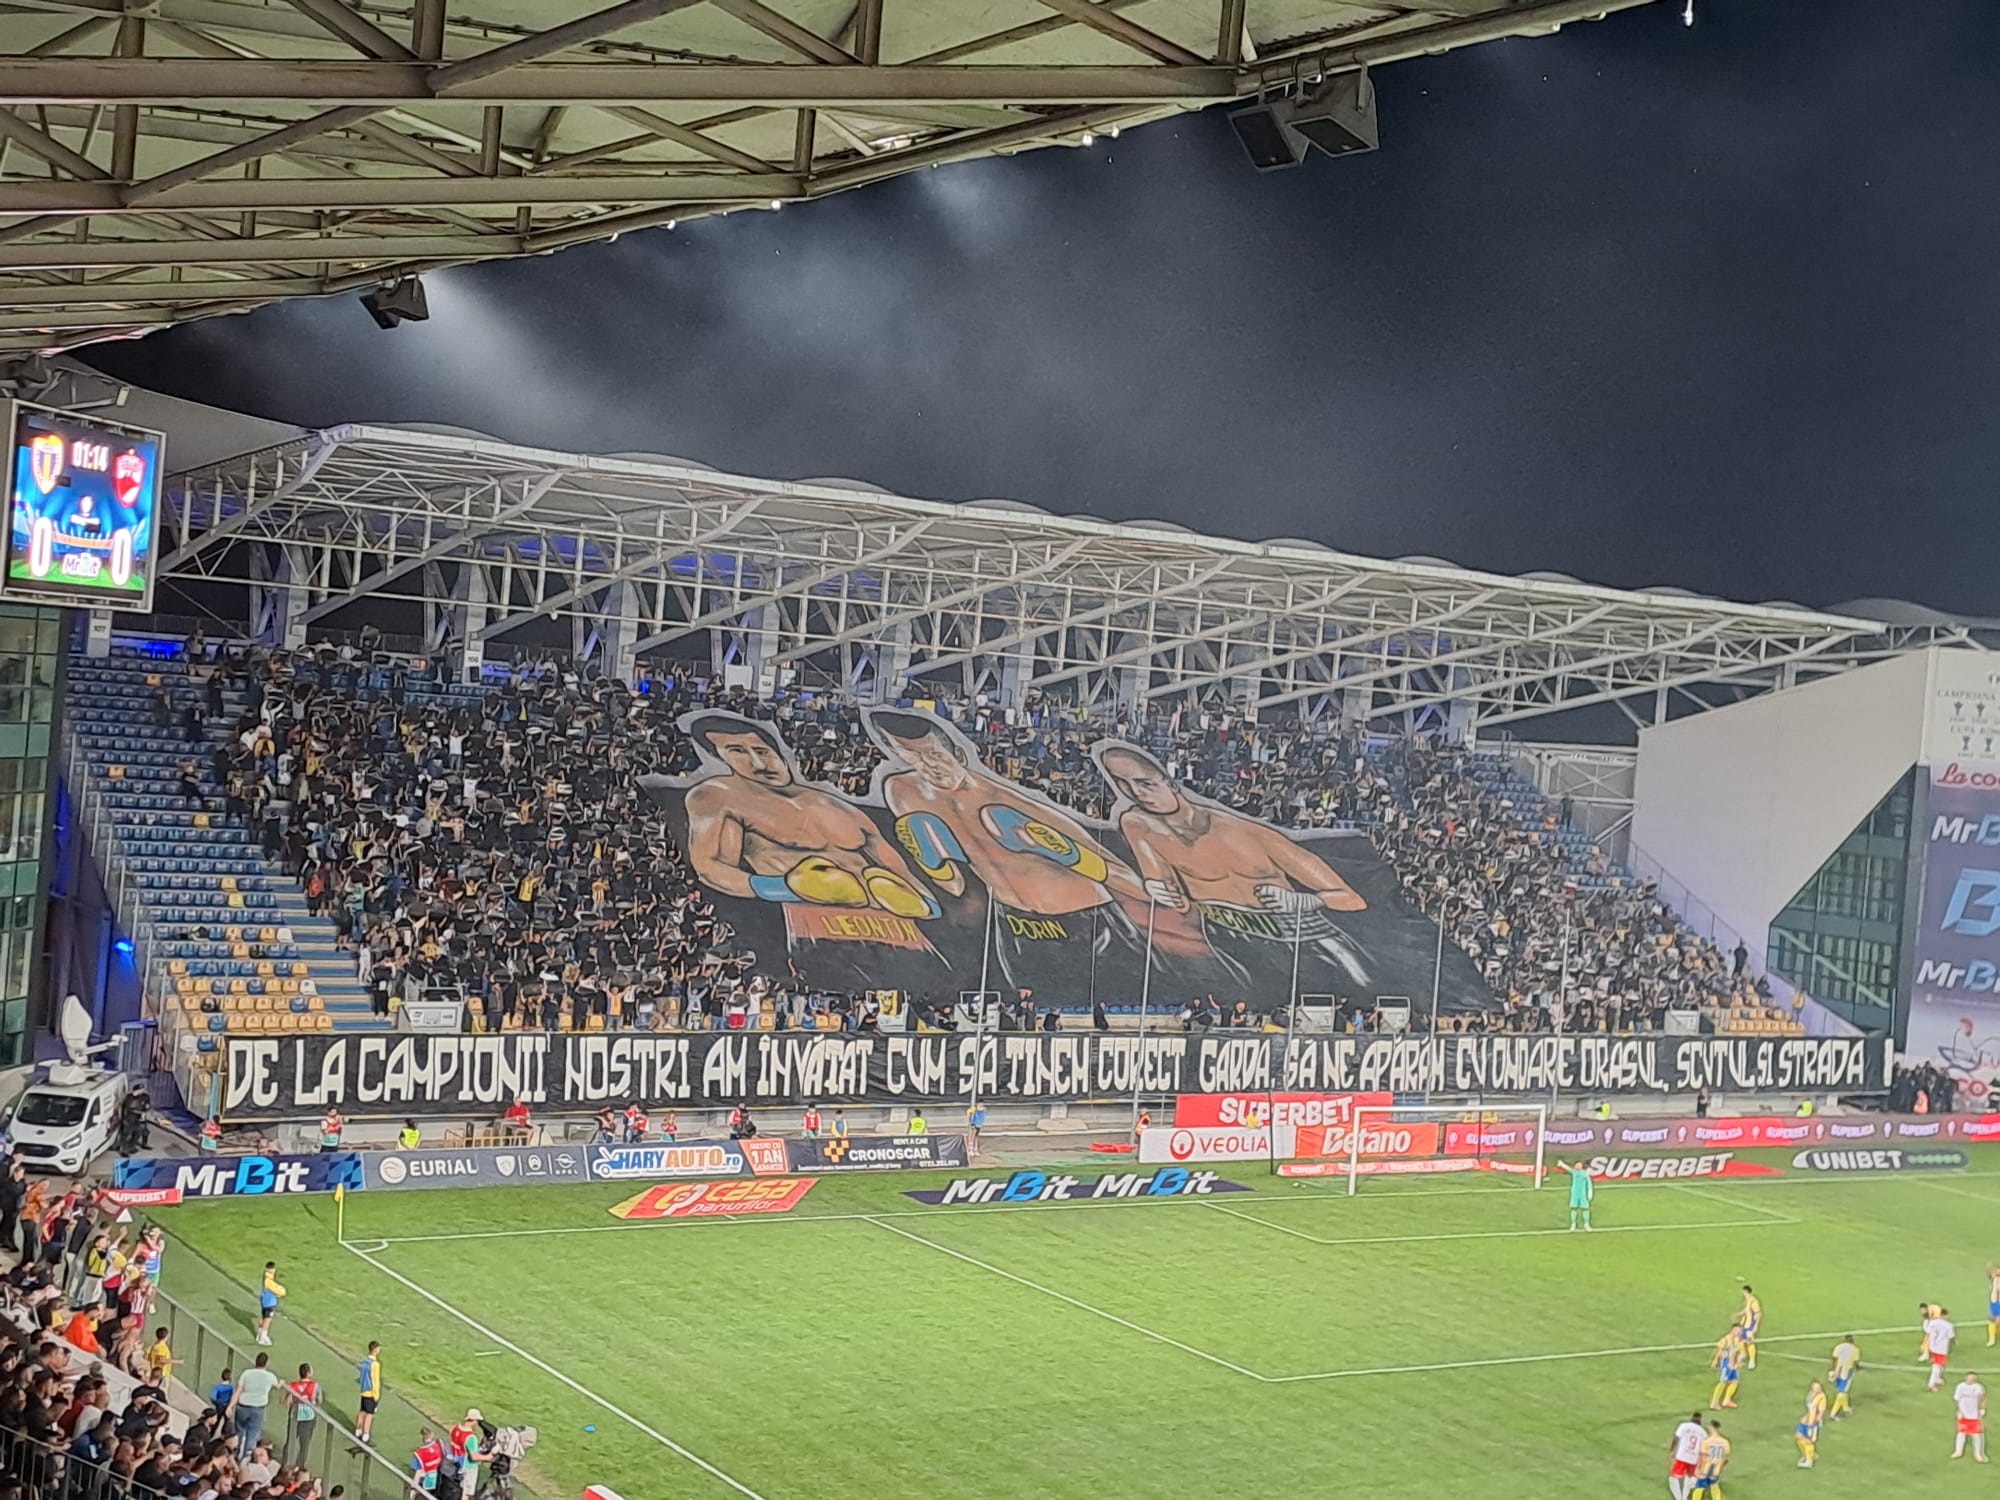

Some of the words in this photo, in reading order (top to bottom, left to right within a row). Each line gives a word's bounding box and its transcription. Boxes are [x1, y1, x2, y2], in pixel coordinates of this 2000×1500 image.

[72, 440, 109, 472] 01:14
[30, 517, 51, 577] 0
[111, 528, 132, 586] 0
[1936, 762, 1968, 784] La
[1970, 772, 2000, 787] co
[1005, 914, 1068, 939] DORIN
[226, 1040, 278, 1108] DE
[294, 1038, 346, 1104] LA
[358, 1036, 546, 1102] CAMPIONII
[703, 1036, 748, 1097] AM
[1098, 1038, 1187, 1091] CORECT
[1323, 1039, 1355, 1090] NE
[1493, 1038, 1575, 1090] ONOARE
[1778, 1039, 1864, 1087] STRADA
[1219, 1097, 1352, 1126] SUPERBET
[1200, 1136, 1268, 1153] VEOLIA
[1321, 1127, 1411, 1155] Betano
[751, 1150, 760, 1164] 1
[763, 1150, 784, 1164] AN
[848, 1147, 931, 1161] CRONOSCAR
[1588, 1153, 1734, 1178] SUPERBET
[1812, 1151, 1902, 1169] UNIBET
[177, 1155, 310, 1197] MrBit
[410, 1158, 478, 1176] EURIAL
[705, 1178, 797, 1200] casa
[942, 1170, 1080, 1205] MrBit
[1092, 1166, 1219, 1198] MrBit
